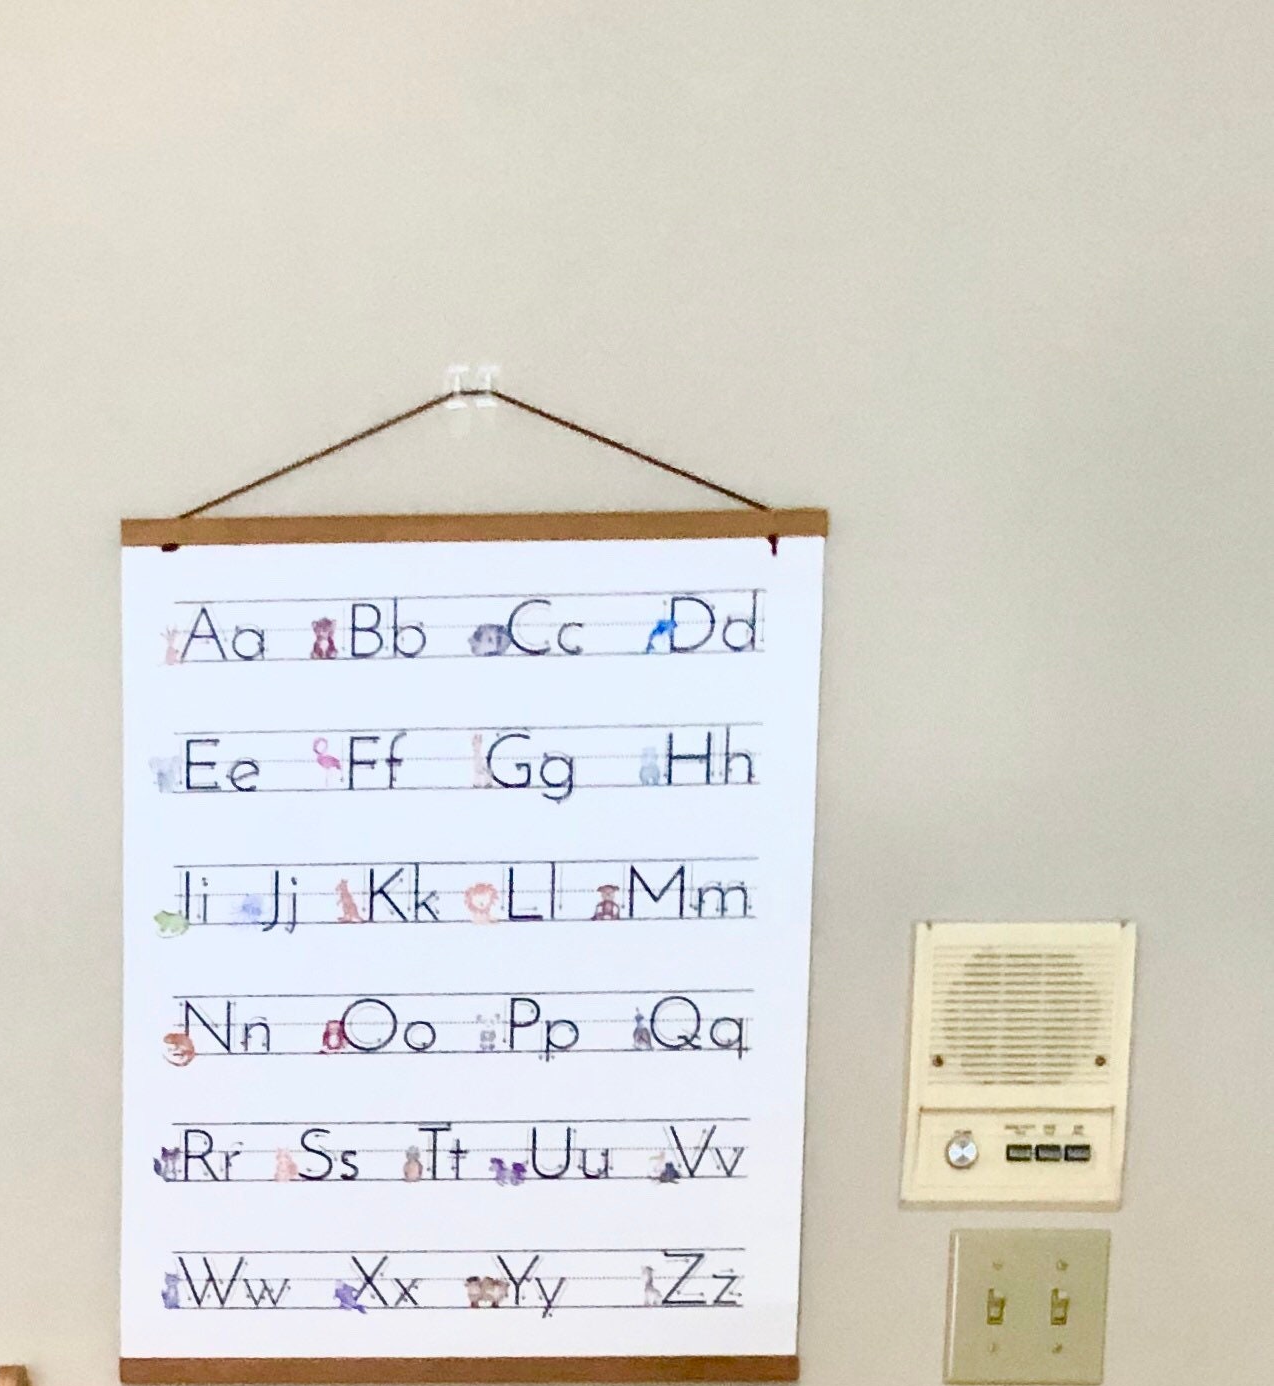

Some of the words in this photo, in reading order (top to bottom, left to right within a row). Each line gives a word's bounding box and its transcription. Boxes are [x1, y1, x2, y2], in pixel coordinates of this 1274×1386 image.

[181, 606, 265, 661] Aa
[350, 596, 426, 659] Bb
[508, 599, 584, 657] Cc
[670, 589, 757, 654] Dd
[185, 738, 261, 791] Ee
[348, 733, 407, 790] Ff
[486, 734, 574, 803] Gg
[666, 726, 754, 786] Hh
[183, 871, 209, 924] Ii
[262, 870, 298, 932] Jj
[368, 862, 441, 922] Kk
[508, 862, 555, 921] Ll
[628, 864, 750, 919] Mm
[182, 999, 271, 1054] Nn
[343, 998, 436, 1053] Oo
[508, 997, 579, 1061] Pp
[649, 996, 744, 1059] Qq
[182, 1129, 241, 1181] Rr
[299, 1128, 360, 1181] Ss
[419, 1123, 469, 1179] Tt
[531, 1127, 611, 1178] Uu
[670, 1125, 744, 1178] Vv
[178, 1256, 289, 1308] Ww
[351, 1255, 420, 1307] Xx
[497, 1255, 566, 1318] Yy
[662, 1253, 739, 1305] Zz
